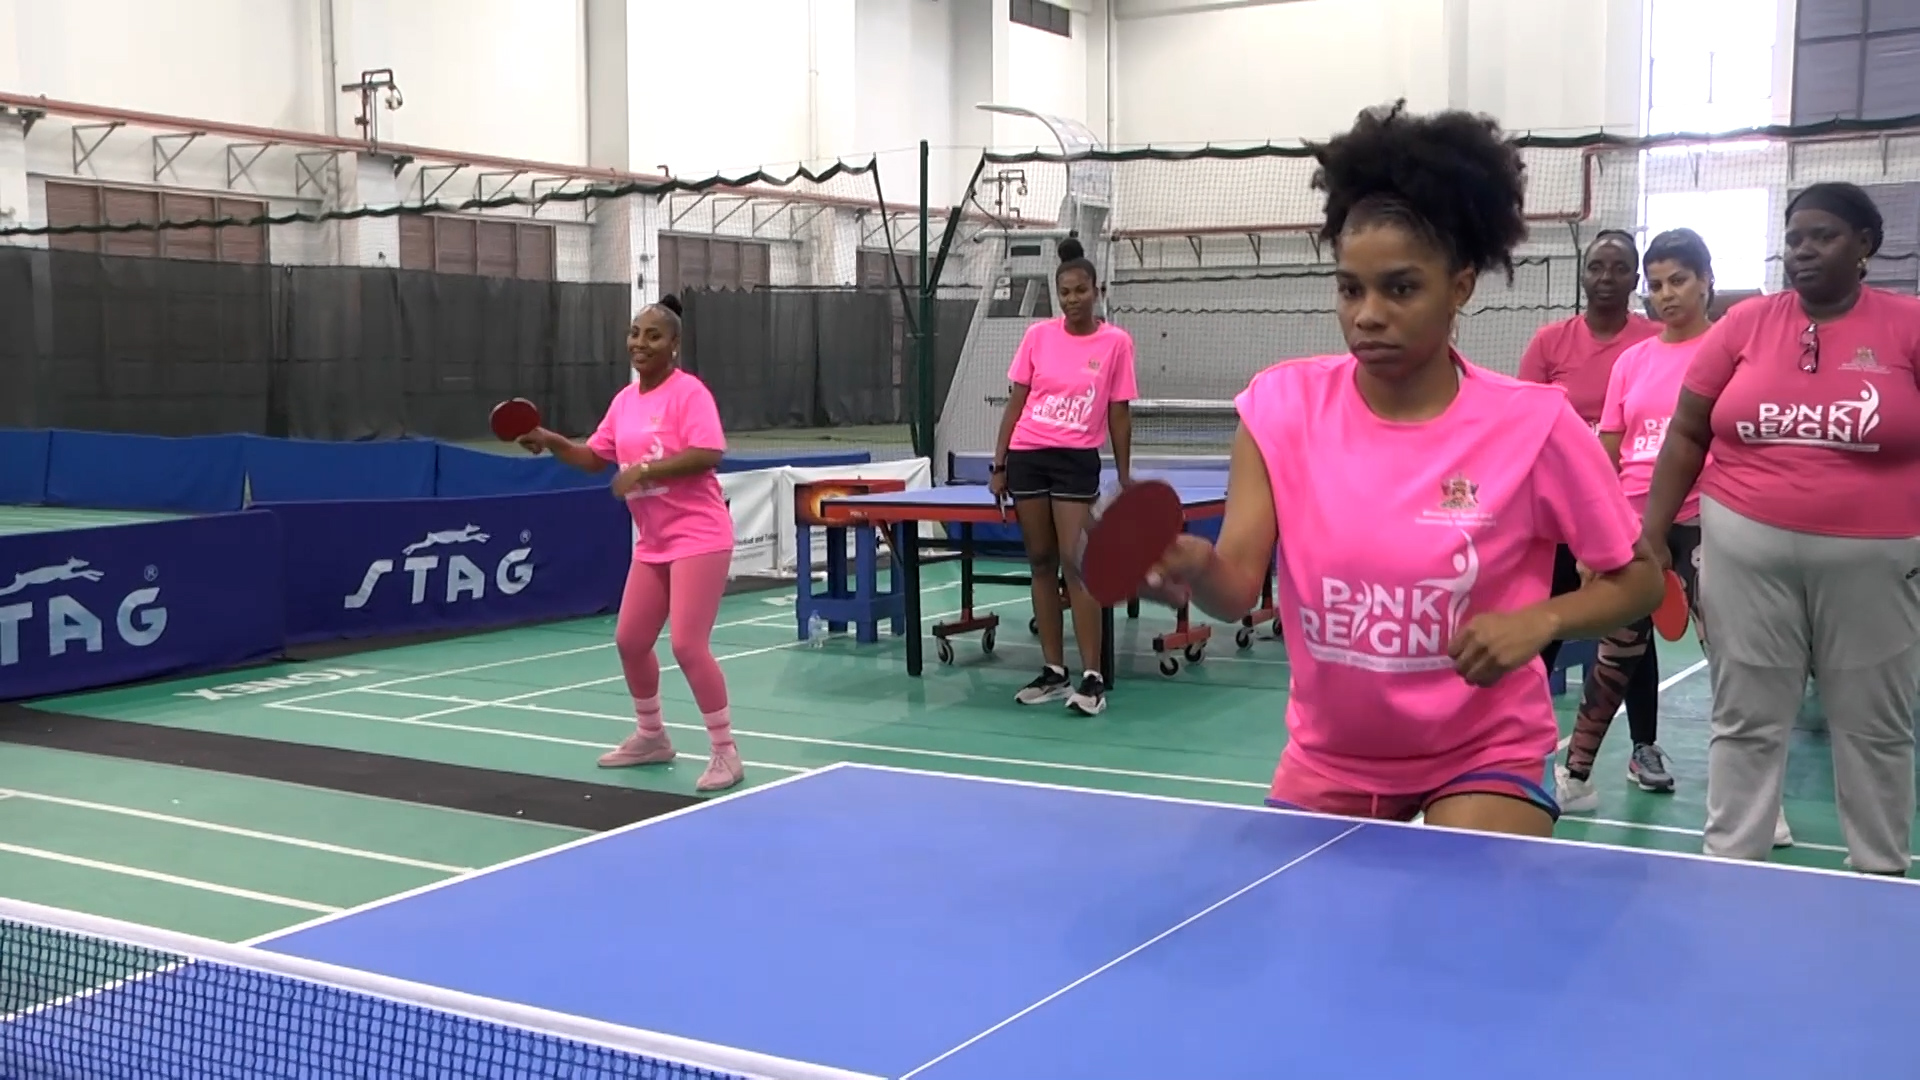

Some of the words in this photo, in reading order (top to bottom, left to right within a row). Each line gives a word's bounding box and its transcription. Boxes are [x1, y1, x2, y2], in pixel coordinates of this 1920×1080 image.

[1735, 421, 1852, 442] REIGN
[1758, 402, 1854, 424] PINK
[344, 547, 535, 609] STAG
[1321, 576, 1445, 621] PINK
[0, 587, 168, 666] TAG
[1299, 604, 1441, 656] REIGN
[172, 668, 379, 701] YONEX
